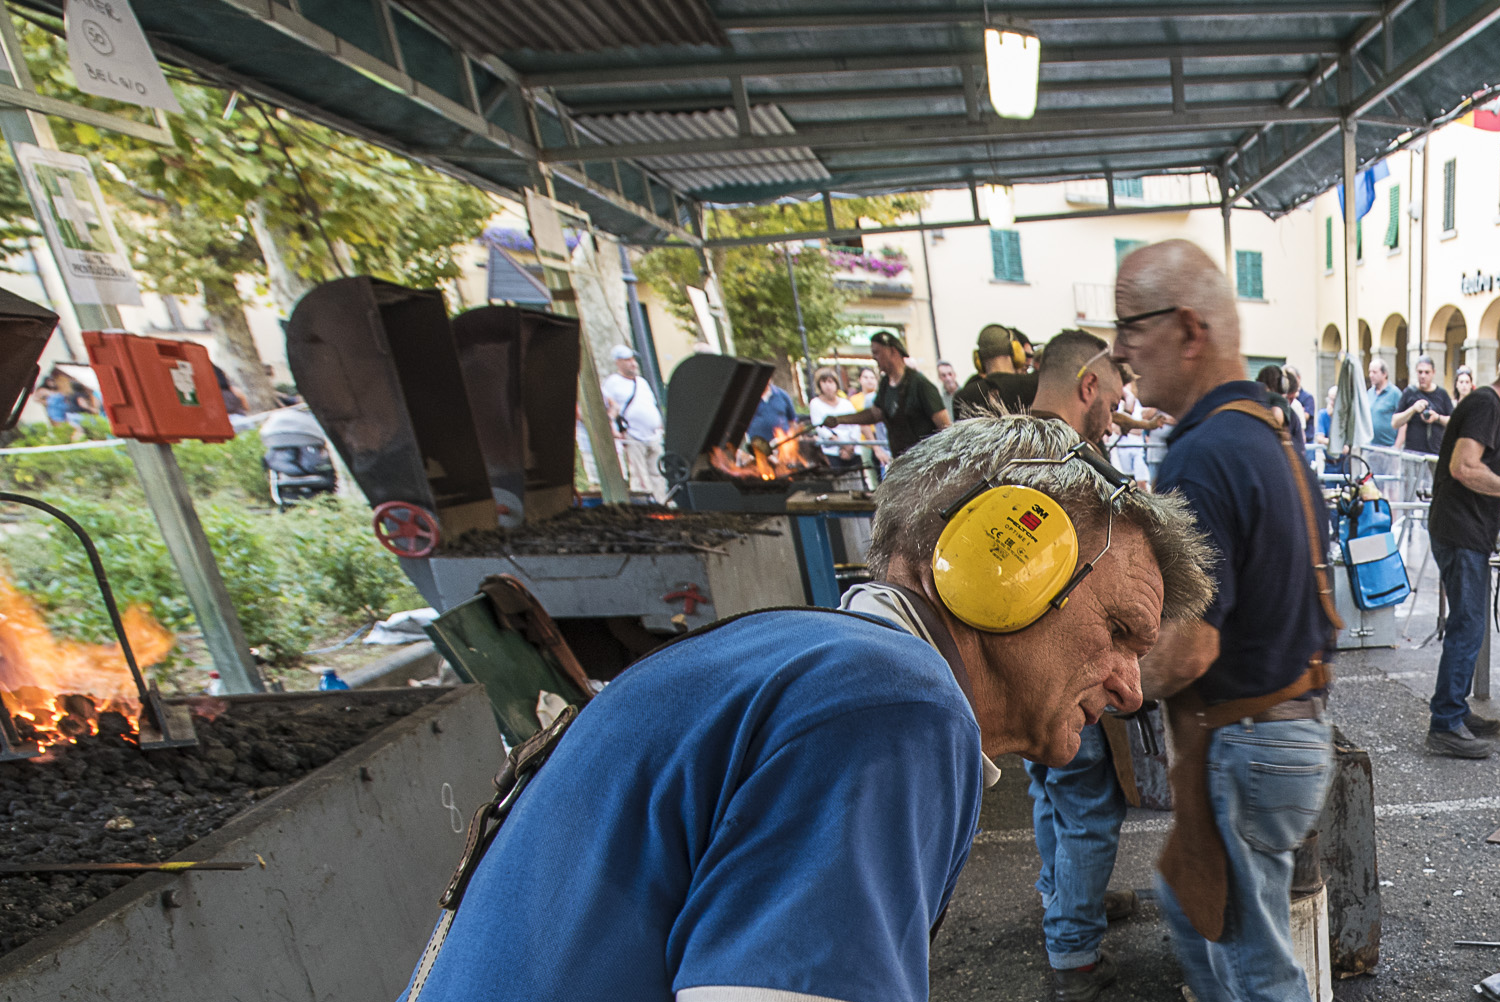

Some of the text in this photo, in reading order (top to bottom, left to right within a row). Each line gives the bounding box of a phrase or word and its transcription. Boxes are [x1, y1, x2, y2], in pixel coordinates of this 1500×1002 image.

[1031, 504, 1049, 519] 3M
[1004, 524, 1026, 542] OPTIME
[1006, 516, 1038, 543] PELTOR
